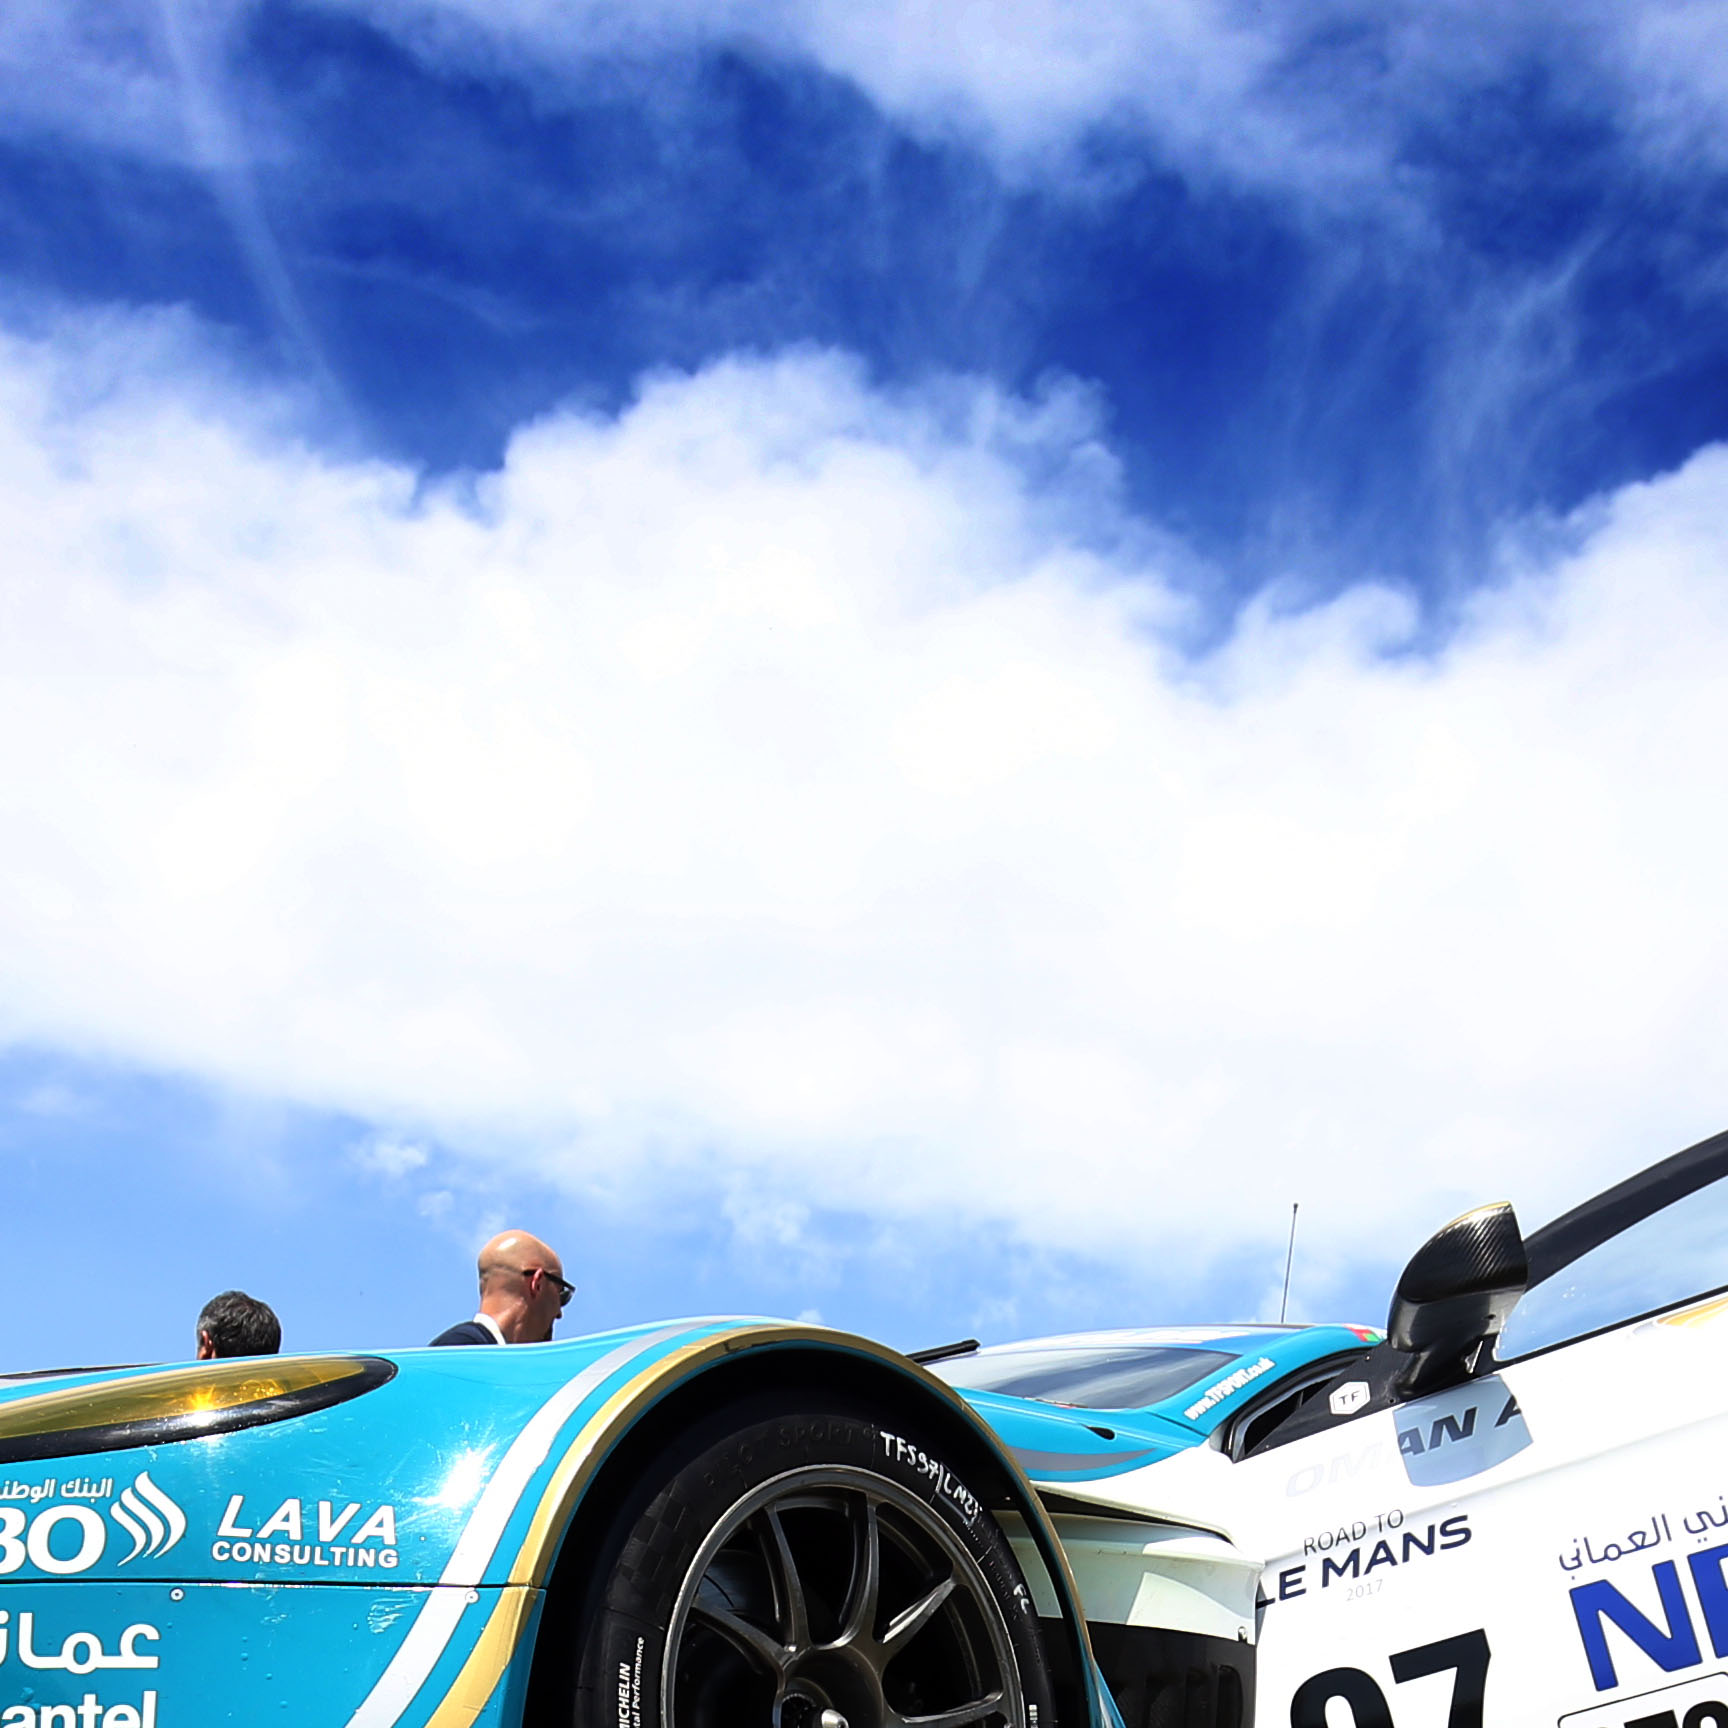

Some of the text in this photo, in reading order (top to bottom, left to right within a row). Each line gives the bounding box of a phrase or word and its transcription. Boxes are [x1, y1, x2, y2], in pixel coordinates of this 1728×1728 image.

[1339, 1391, 1361, 1407] TF
[60, 1477, 112, 1502] البنك
[217, 1494, 399, 1546] LAVA
[1303, 1508, 1405, 1557] ROAD TO
[211, 1540, 400, 1569] CONSULTING
[1321, 1513, 1473, 1588] MANS
[1559, 1513, 1673, 1581] العماني
[1346, 1578, 1384, 1602] 2017
[632, 1636, 645, 1709] Performance
